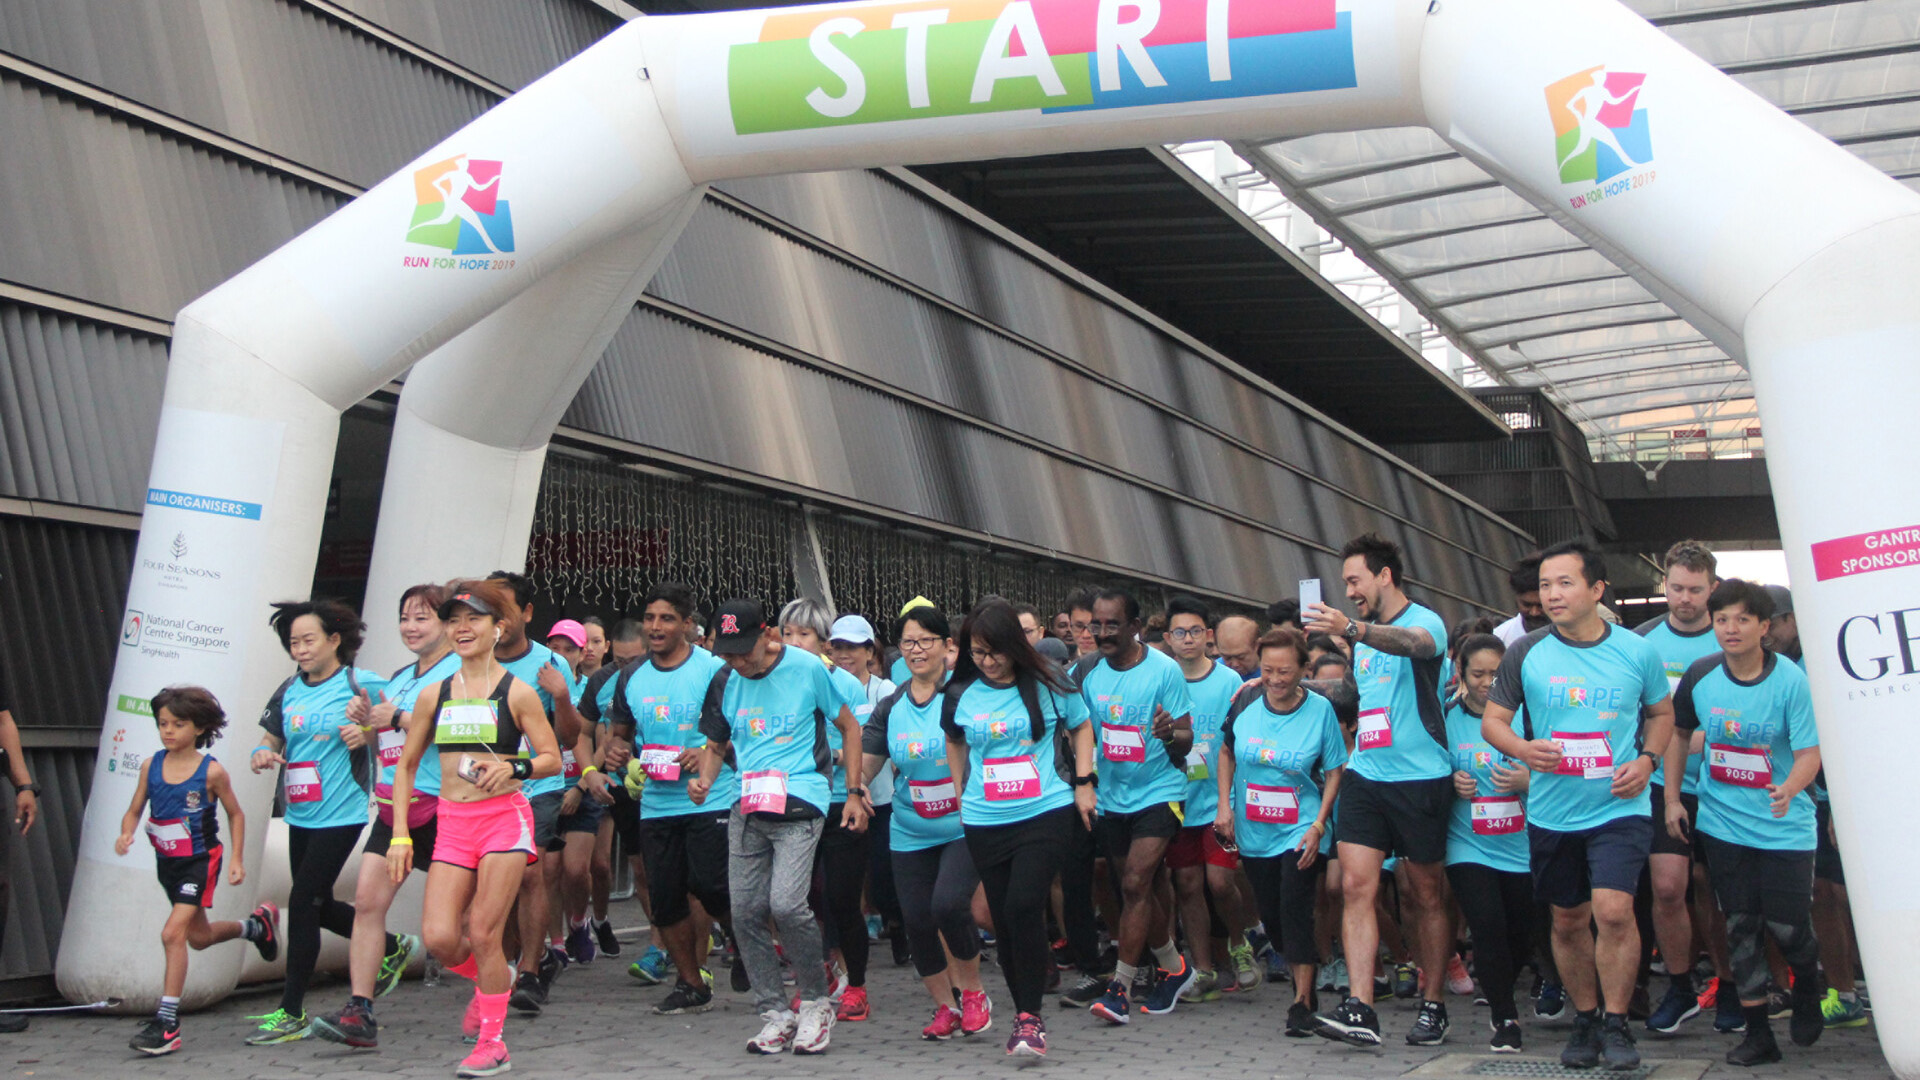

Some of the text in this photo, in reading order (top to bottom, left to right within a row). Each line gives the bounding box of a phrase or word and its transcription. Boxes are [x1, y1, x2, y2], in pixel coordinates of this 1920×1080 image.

[1570, 171, 1656, 209] RUN FOR HOPE 2019
[403, 256, 516, 270] RUN FOR HOPE 2019
[150, 491, 247, 516] MAIN ORGANISERS:
[1864, 529, 1920, 549] GANTR
[1841, 548, 1920, 573] SPONSOR
[143, 559, 222, 579] FOUR SEASONS
[146, 614, 224, 634] National Cancer
[144, 625, 231, 649] Centre Singapore
[141, 645, 180, 660] SingHealth
[1550, 676, 1568, 684] RUN
[1848, 681, 1920, 700] ENERG
[126, 698, 153, 714] IN AI
[450, 724, 481, 735] 8263
[123, 752, 140, 761] NCC
[1567, 757, 1597, 768] 9158
[647, 765, 668, 774] 4415
[1726, 768, 1755, 781] 9050
[997, 780, 1025, 793] 3227
[925, 801, 951, 812] 3226
[1258, 807, 1285, 817] 9325
[1487, 818, 1513, 828] 3474
